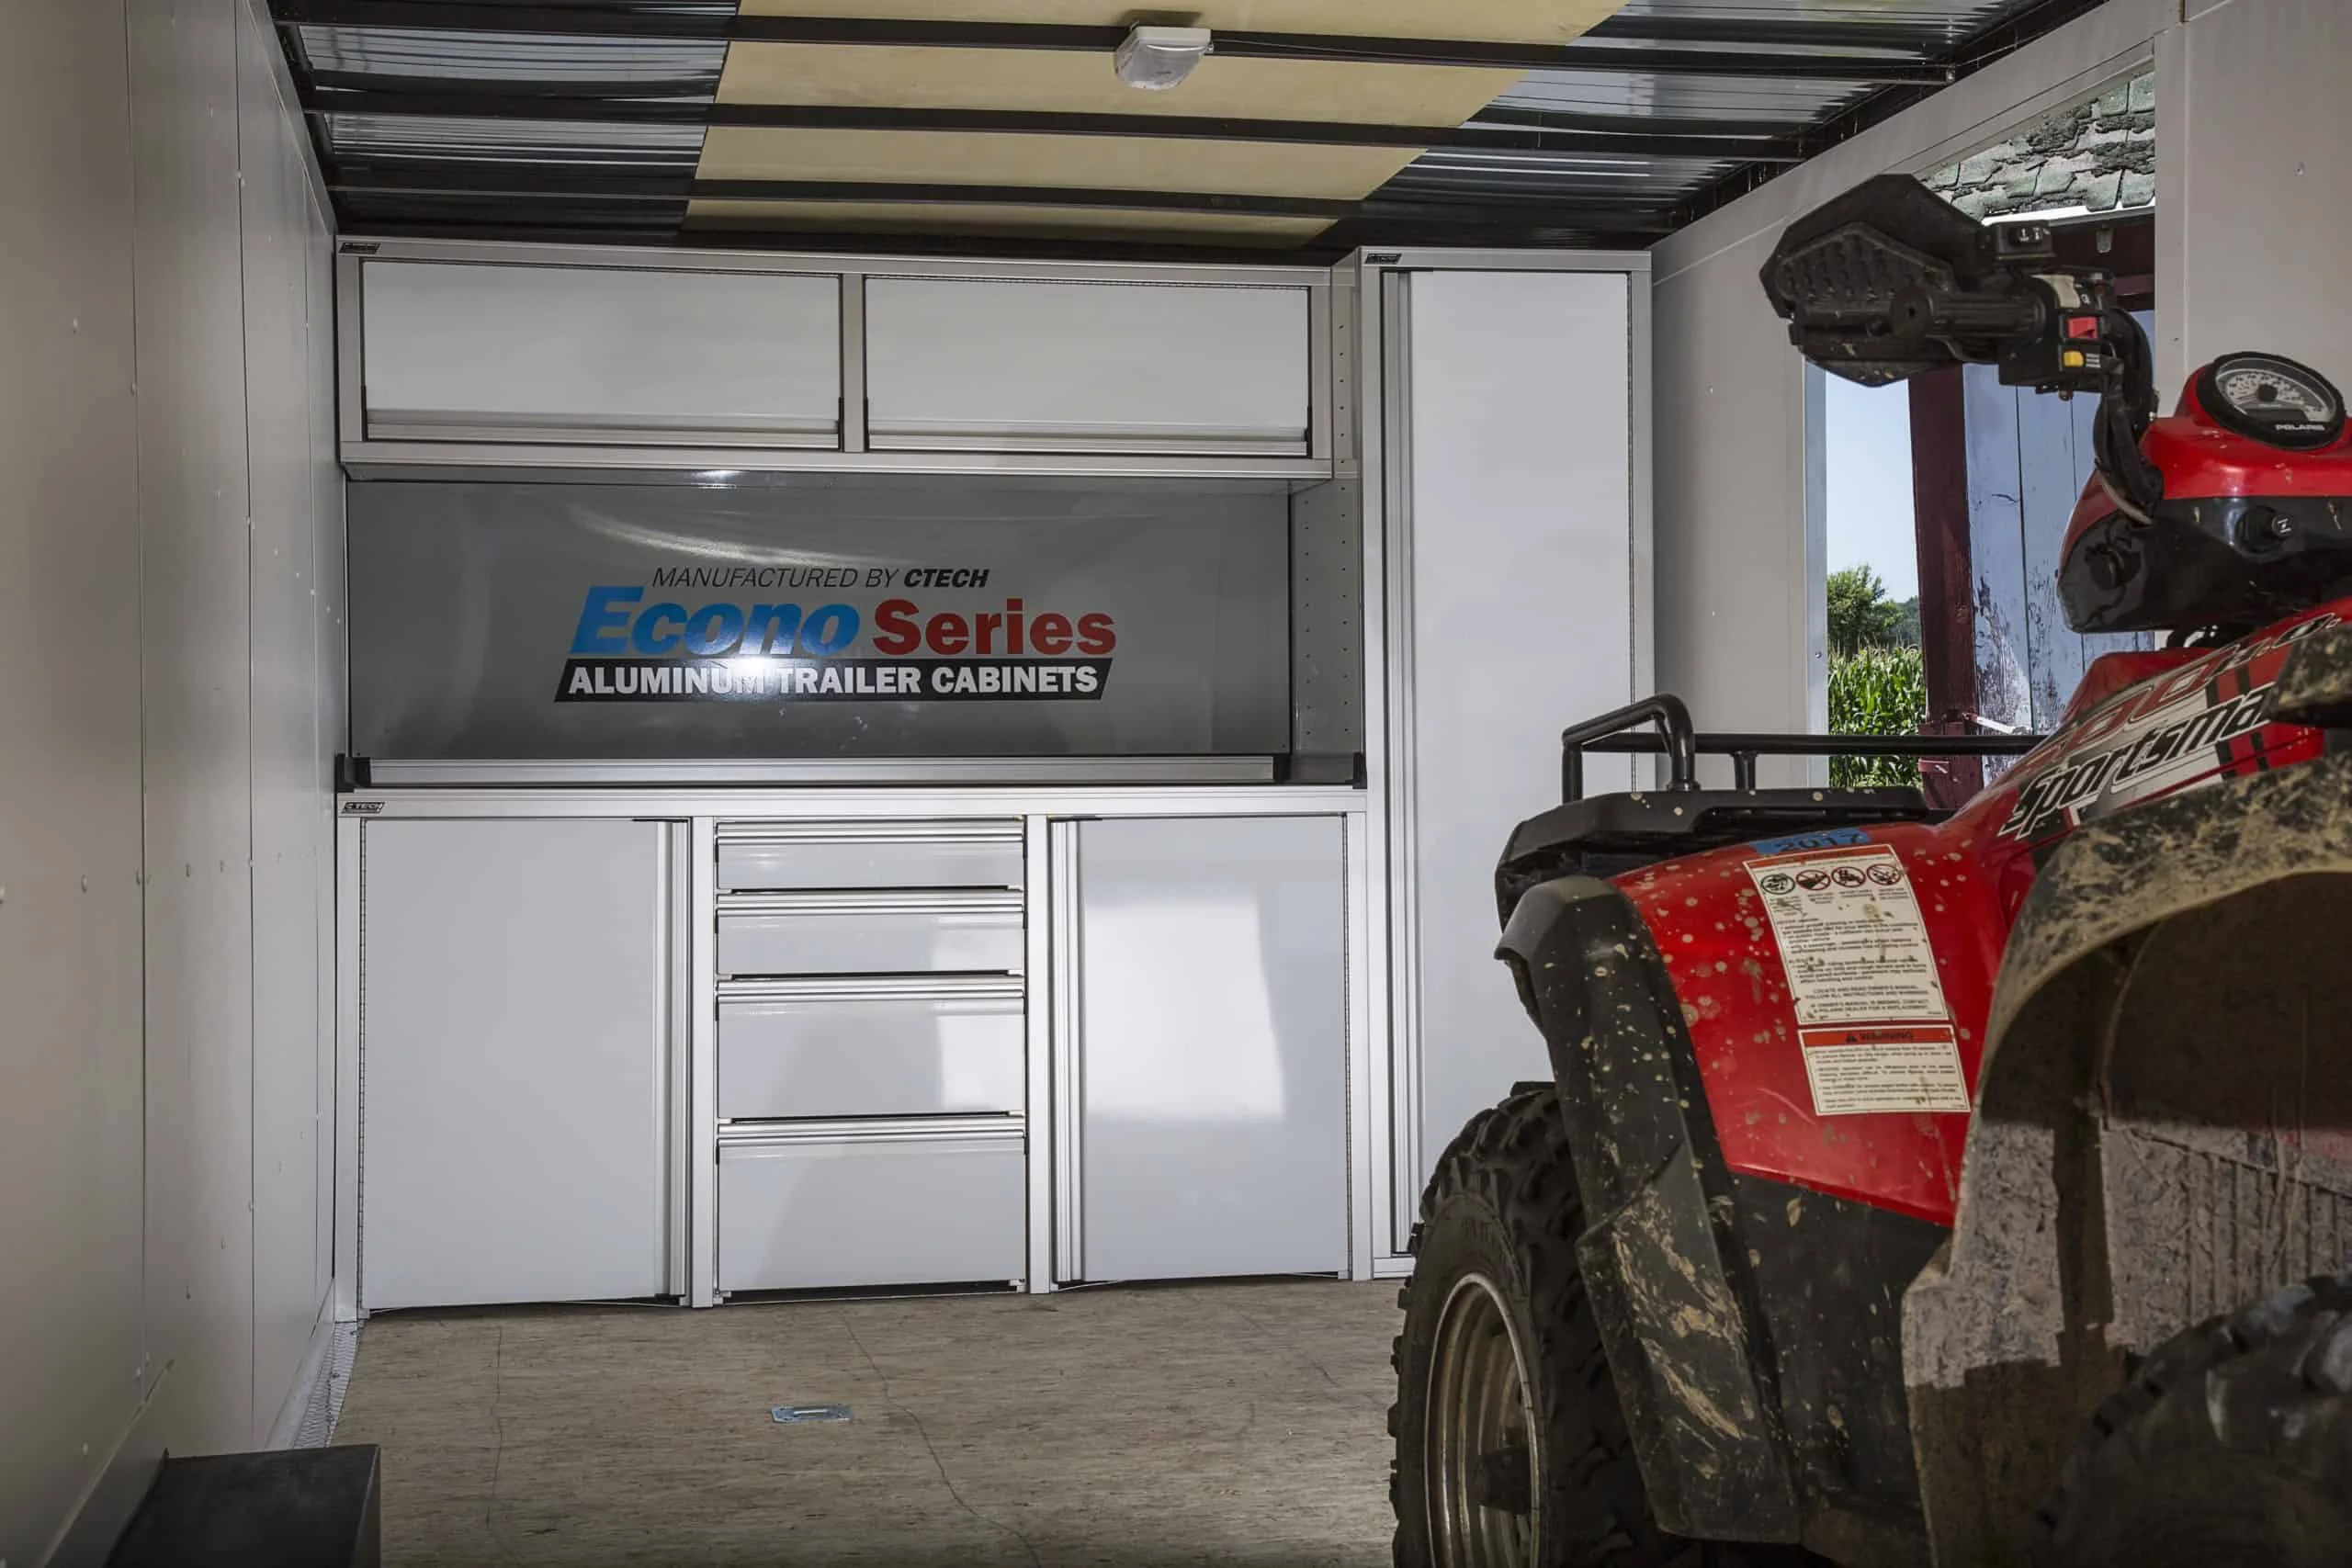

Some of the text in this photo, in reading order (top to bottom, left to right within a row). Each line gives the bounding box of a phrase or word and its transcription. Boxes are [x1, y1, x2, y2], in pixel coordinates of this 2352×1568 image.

[652, 567, 989, 588] MANUFACTURED BY CTECH
[570, 586, 1116, 655] Econo Series
[569, 666, 1099, 694] ALUMINUM TRAILER CABINETS
[1775, 830, 1864, 852] 2017
